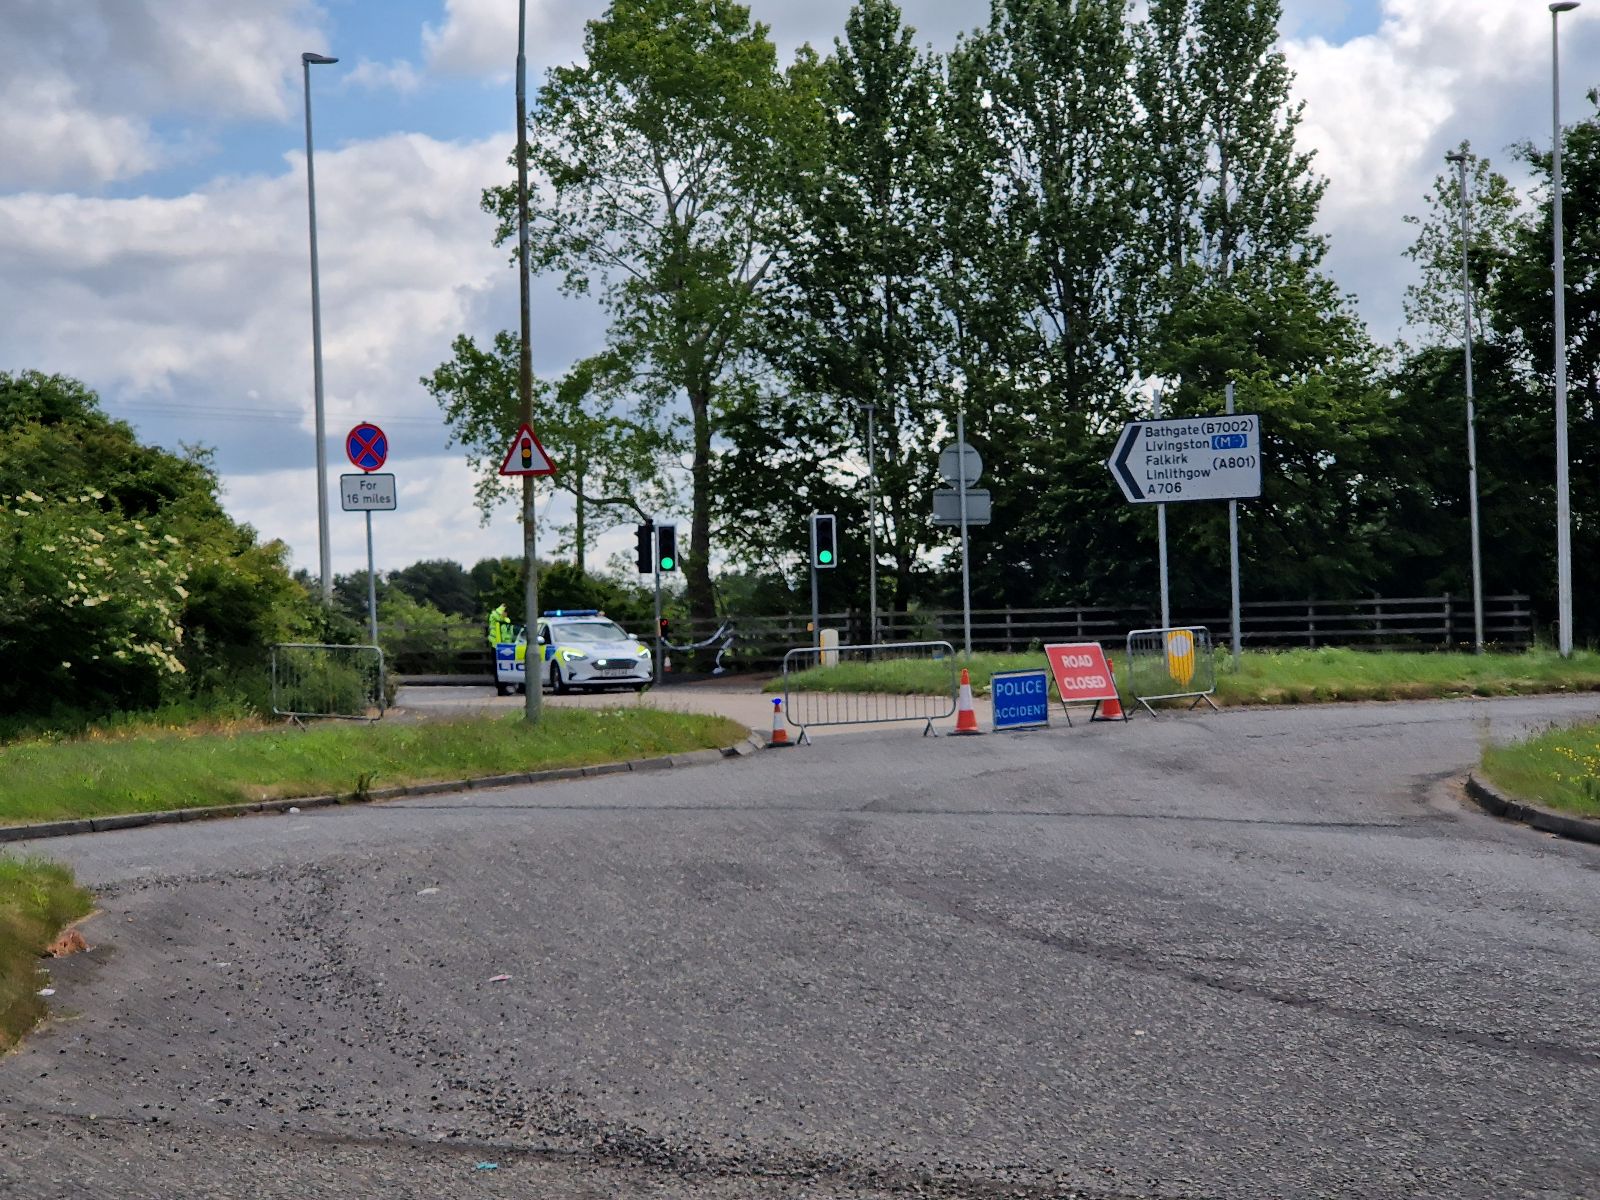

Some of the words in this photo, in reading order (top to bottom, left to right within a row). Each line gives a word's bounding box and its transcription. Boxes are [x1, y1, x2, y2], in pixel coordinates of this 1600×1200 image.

[1145, 424, 1199, 439] Bathgate
[1201, 419, 1253, 435] (B7002)
[1145, 439, 1210, 452] Livingston
[1214, 434, 1245, 449] (M)
[1146, 454, 1188, 466] Falkirk
[1213, 456, 1256, 470] (A801)
[1146, 468, 1211, 481] Linlithgow
[360, 480, 377, 490] For
[1148, 482, 1182, 494] A706
[347, 493, 359, 504] 16
[363, 493, 391, 504] miles
[499, 663, 527, 671] LIC
[1061, 655, 1093, 668] ROAD
[996, 680, 1042, 696] POLICE
[1064, 675, 1107, 690] CLOSED
[995, 704, 1046, 719] ACCIDENT
